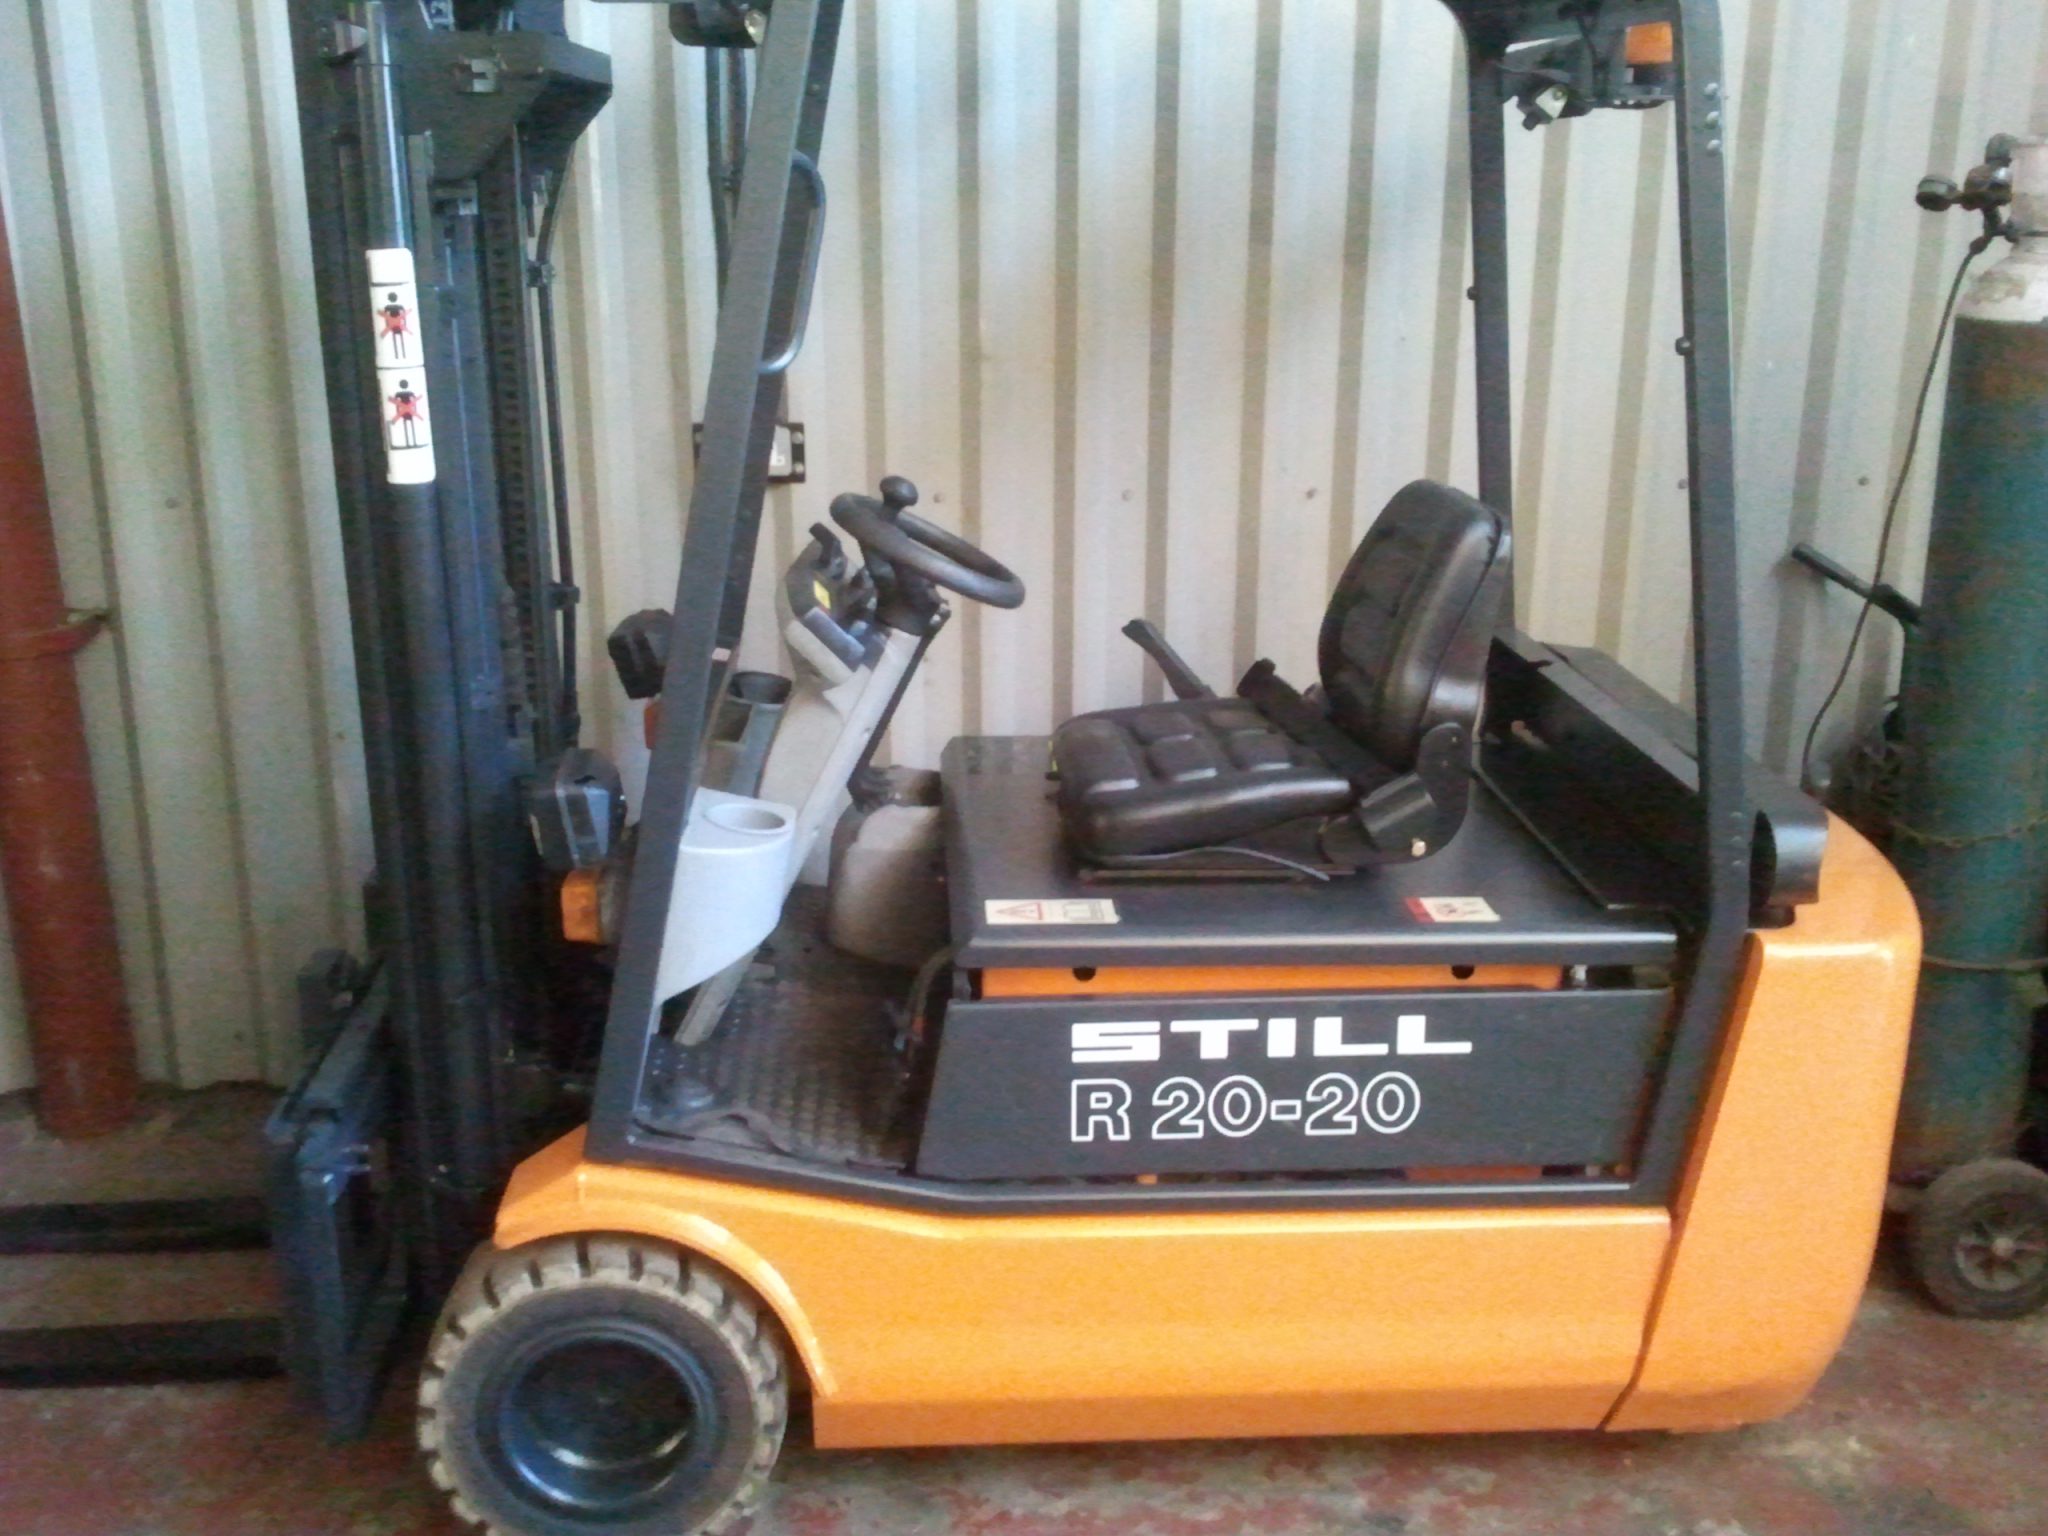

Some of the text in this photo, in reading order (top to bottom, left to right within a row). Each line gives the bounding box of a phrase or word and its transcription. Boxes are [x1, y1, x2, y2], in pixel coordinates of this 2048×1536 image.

[1070, 1014, 1474, 1064] STILL
[1070, 1070, 1422, 1143] R 20-20
